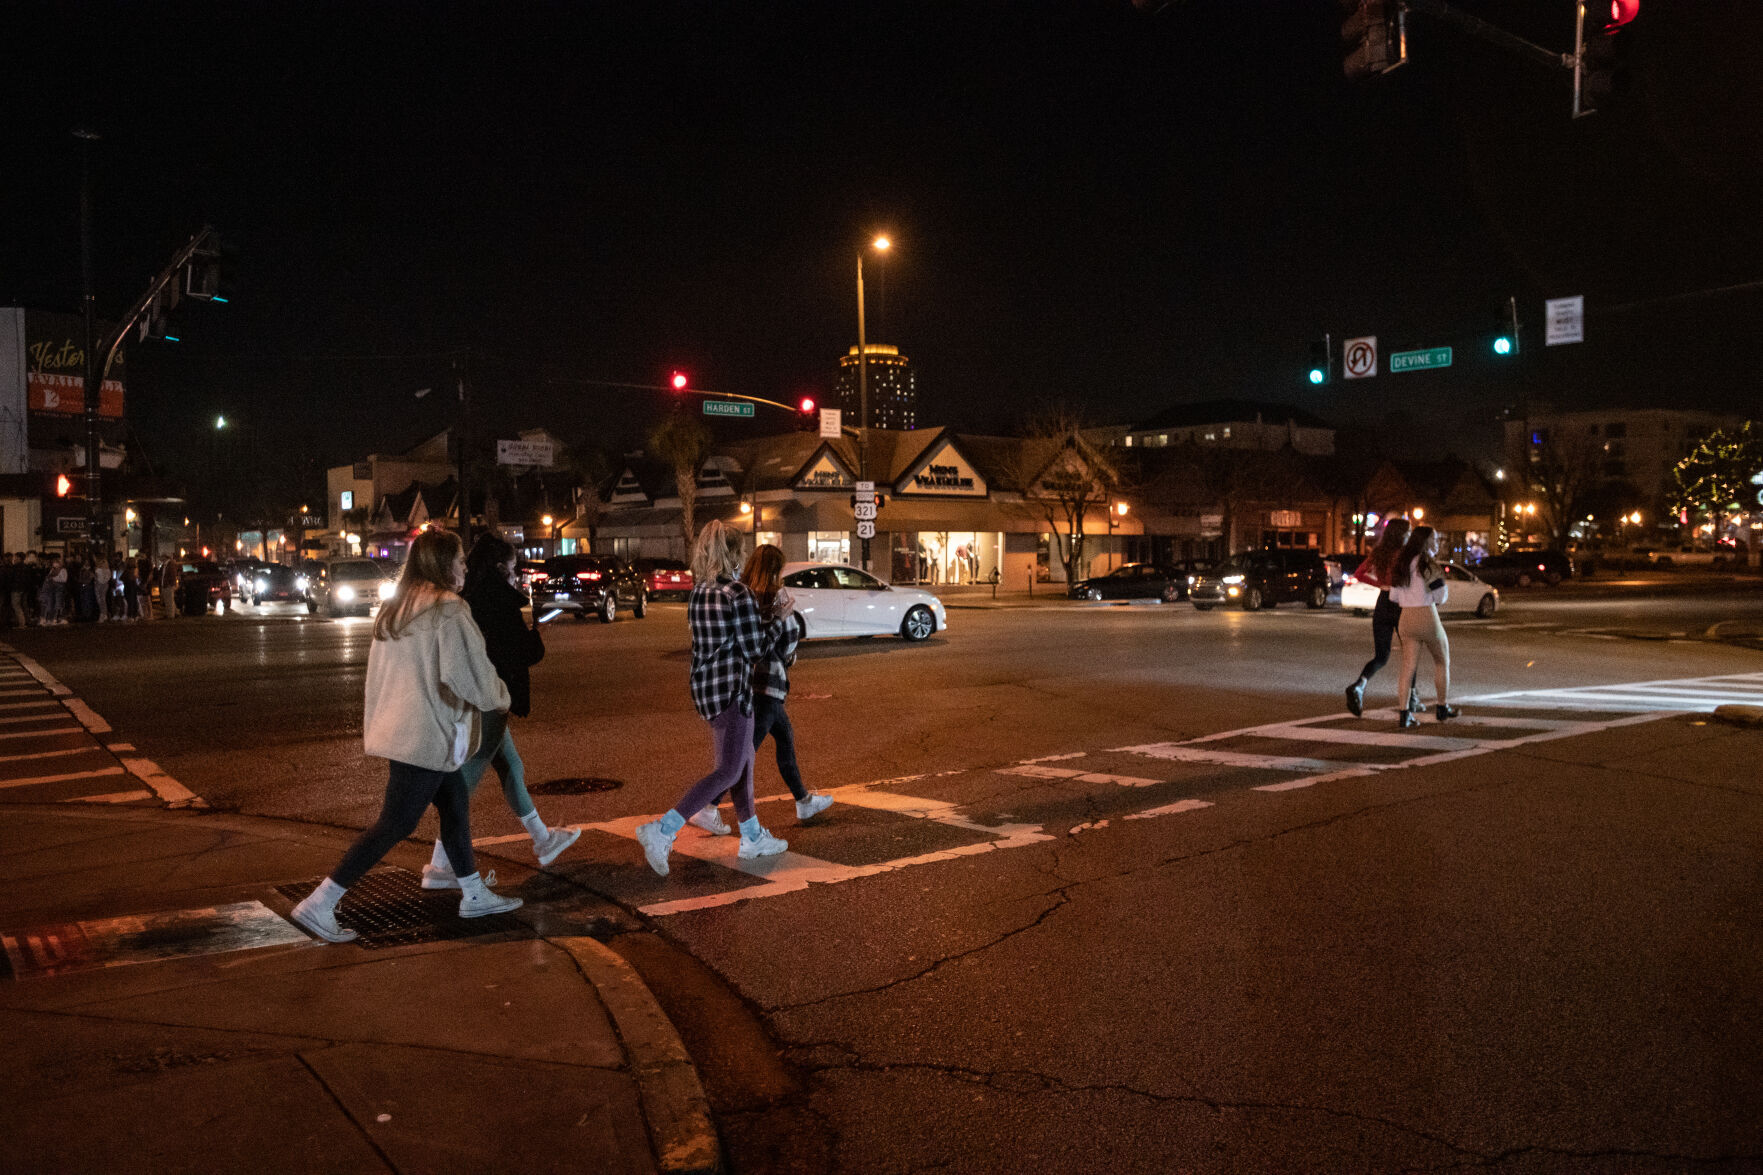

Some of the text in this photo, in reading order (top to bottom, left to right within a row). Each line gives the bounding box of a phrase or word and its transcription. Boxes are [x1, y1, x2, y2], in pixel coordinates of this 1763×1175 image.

[1394, 353, 1448, 369] DEVINE ST
[706, 403, 751, 415] HARDEN ST
[857, 505, 873, 517] 321
[860, 524, 873, 536] 21
